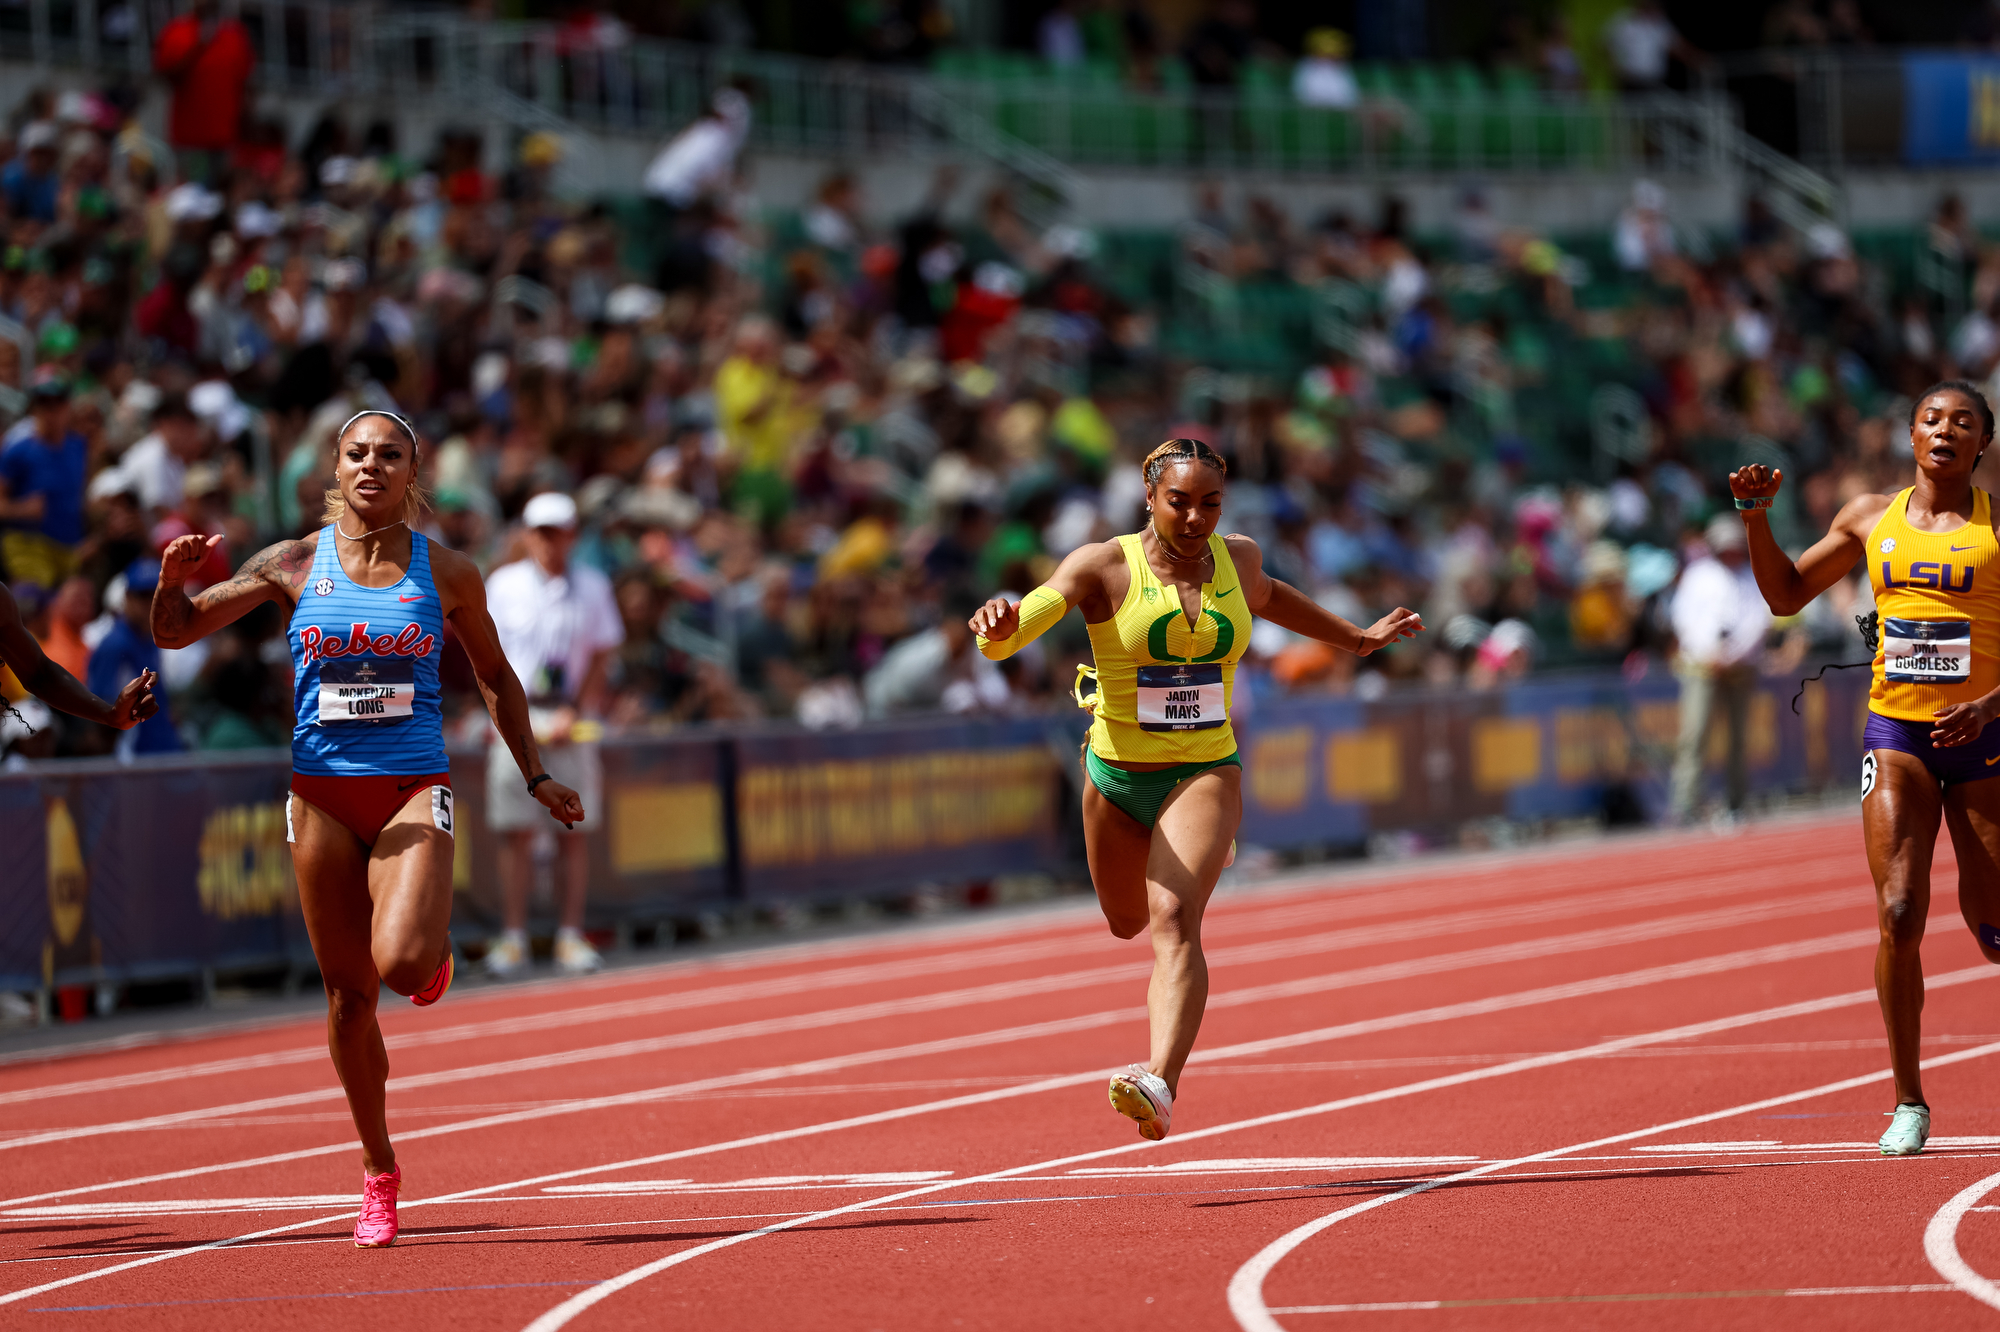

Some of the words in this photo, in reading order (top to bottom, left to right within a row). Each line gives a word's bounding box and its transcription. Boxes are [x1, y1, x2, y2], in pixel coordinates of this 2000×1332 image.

[1882, 561, 1974, 593] LSU
[316, 578, 334, 595] SEC
[301, 622, 434, 667] Rebels
[1913, 644, 1938, 654] TIMA
[339, 687, 396, 699] MCKENZIE
[1166, 689, 1199, 701] JADYN
[348, 700, 385, 715] LONG
[1165, 704, 1200, 719] MAYS
[1863, 756, 1874, 796] 3
[440, 788, 451, 831] 5
